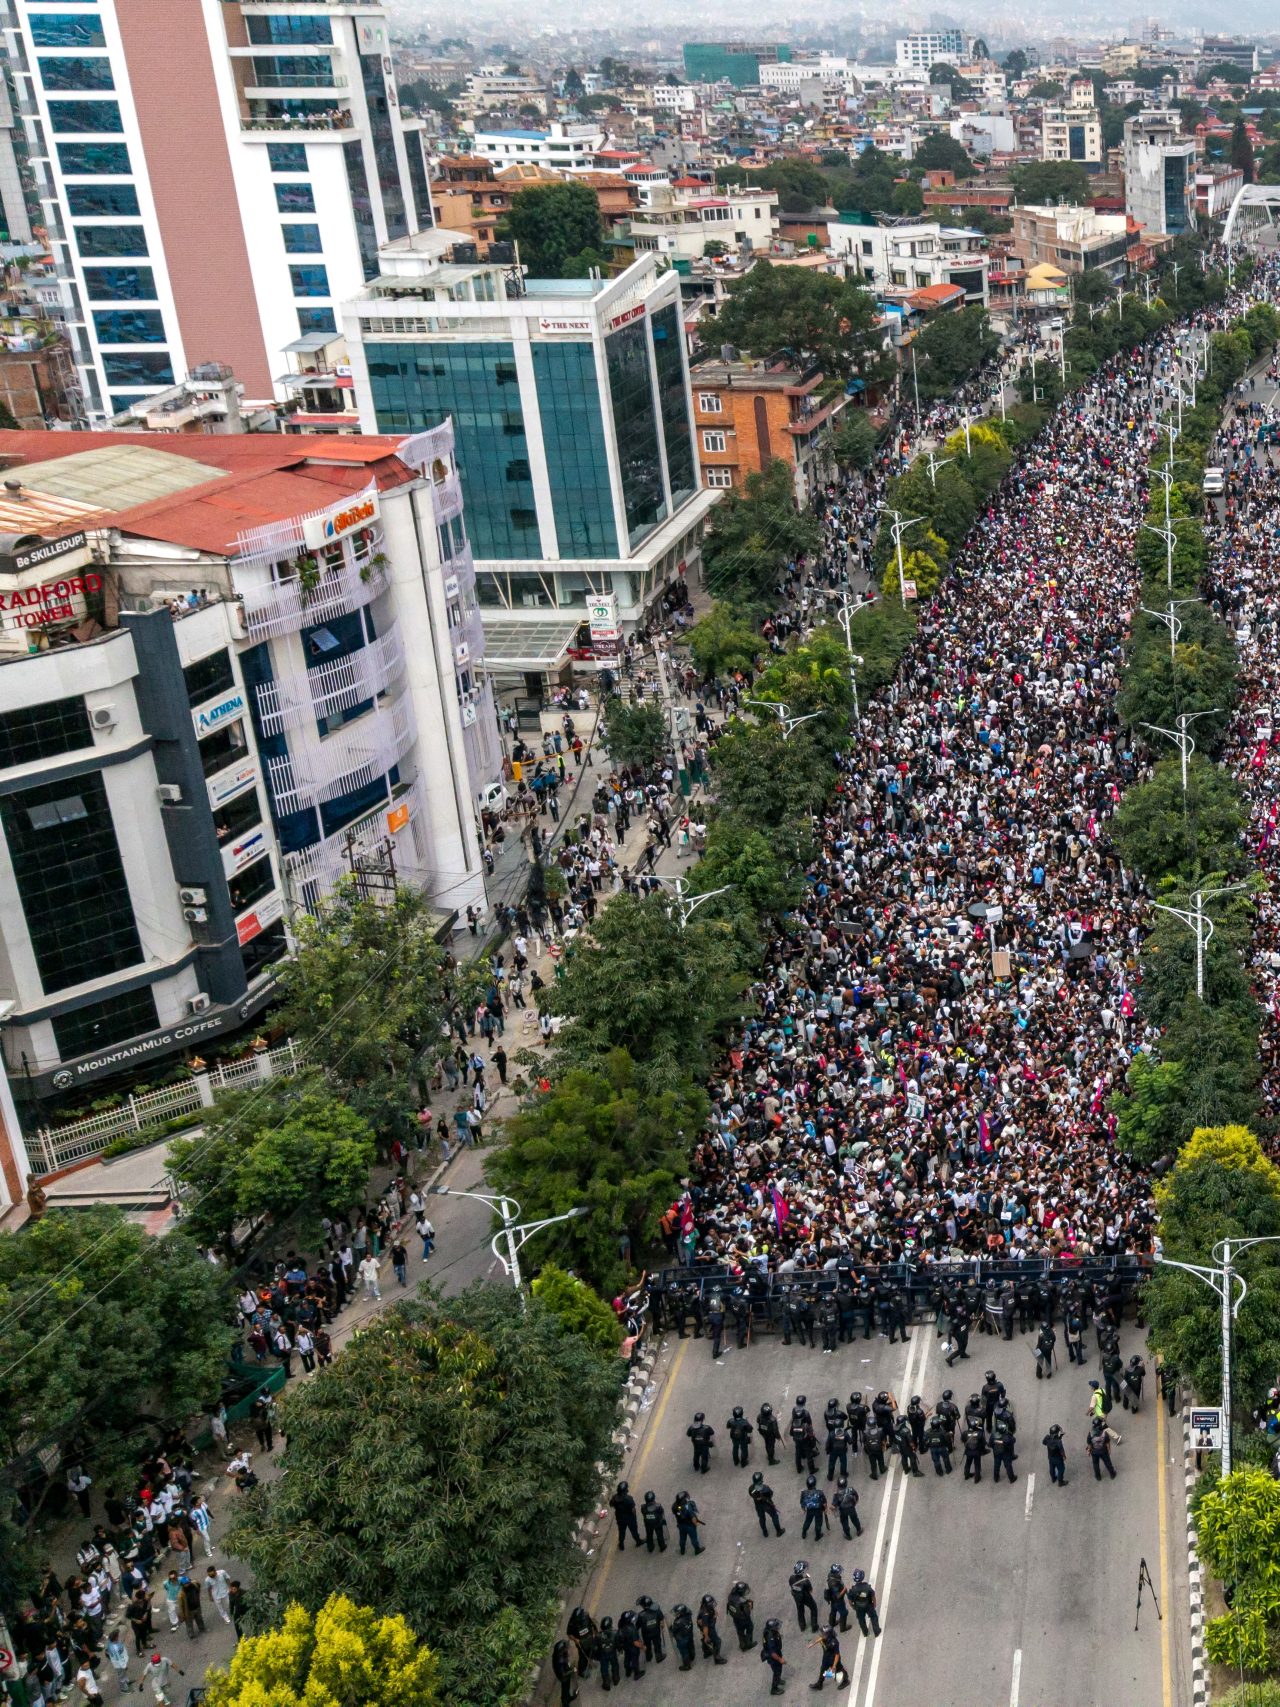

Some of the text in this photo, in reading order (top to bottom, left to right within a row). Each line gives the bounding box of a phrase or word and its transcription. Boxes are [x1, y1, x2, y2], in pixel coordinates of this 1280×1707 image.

[16, 534, 84, 568] Be SKILLEDUP!
[14, 603, 74, 628] TOWER
[209, 696, 243, 721] ATHENA
